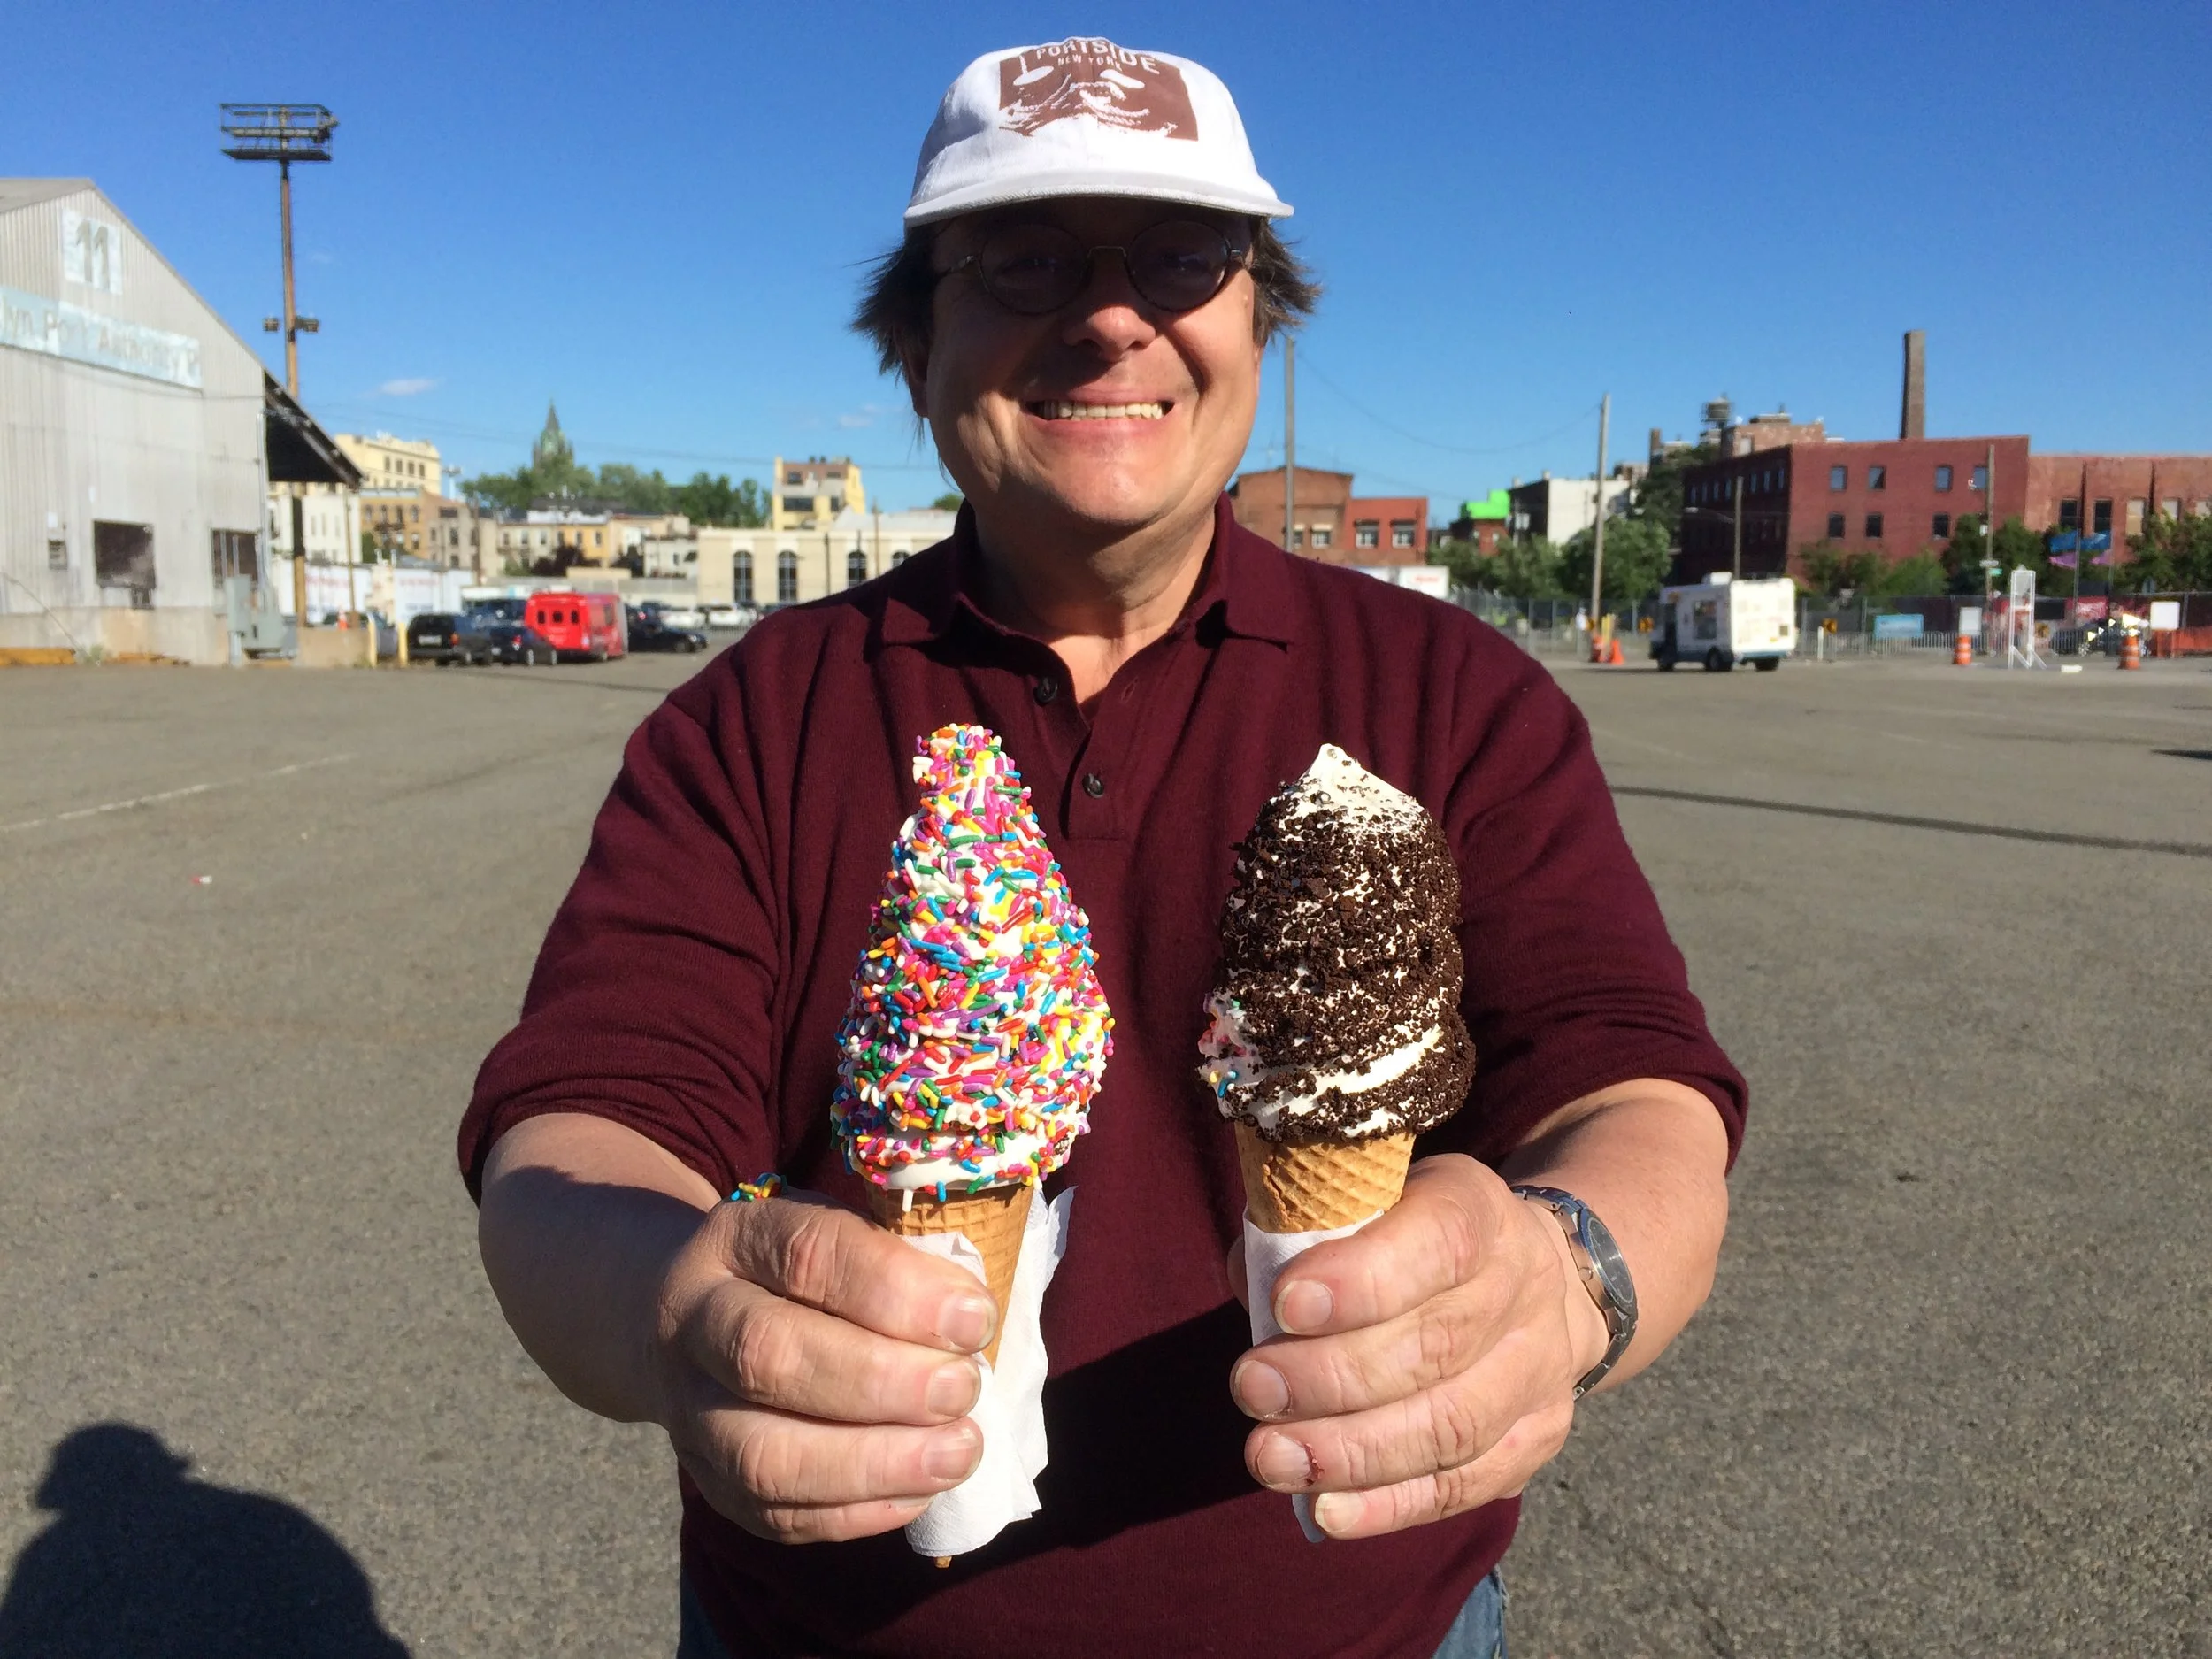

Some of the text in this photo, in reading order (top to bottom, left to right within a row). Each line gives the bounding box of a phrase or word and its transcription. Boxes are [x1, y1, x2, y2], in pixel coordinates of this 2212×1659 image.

[1036, 39, 1160, 75] PORTSIDE
[1057, 54, 1122, 72] NEW YORK
[75, 219, 111, 290] 11
